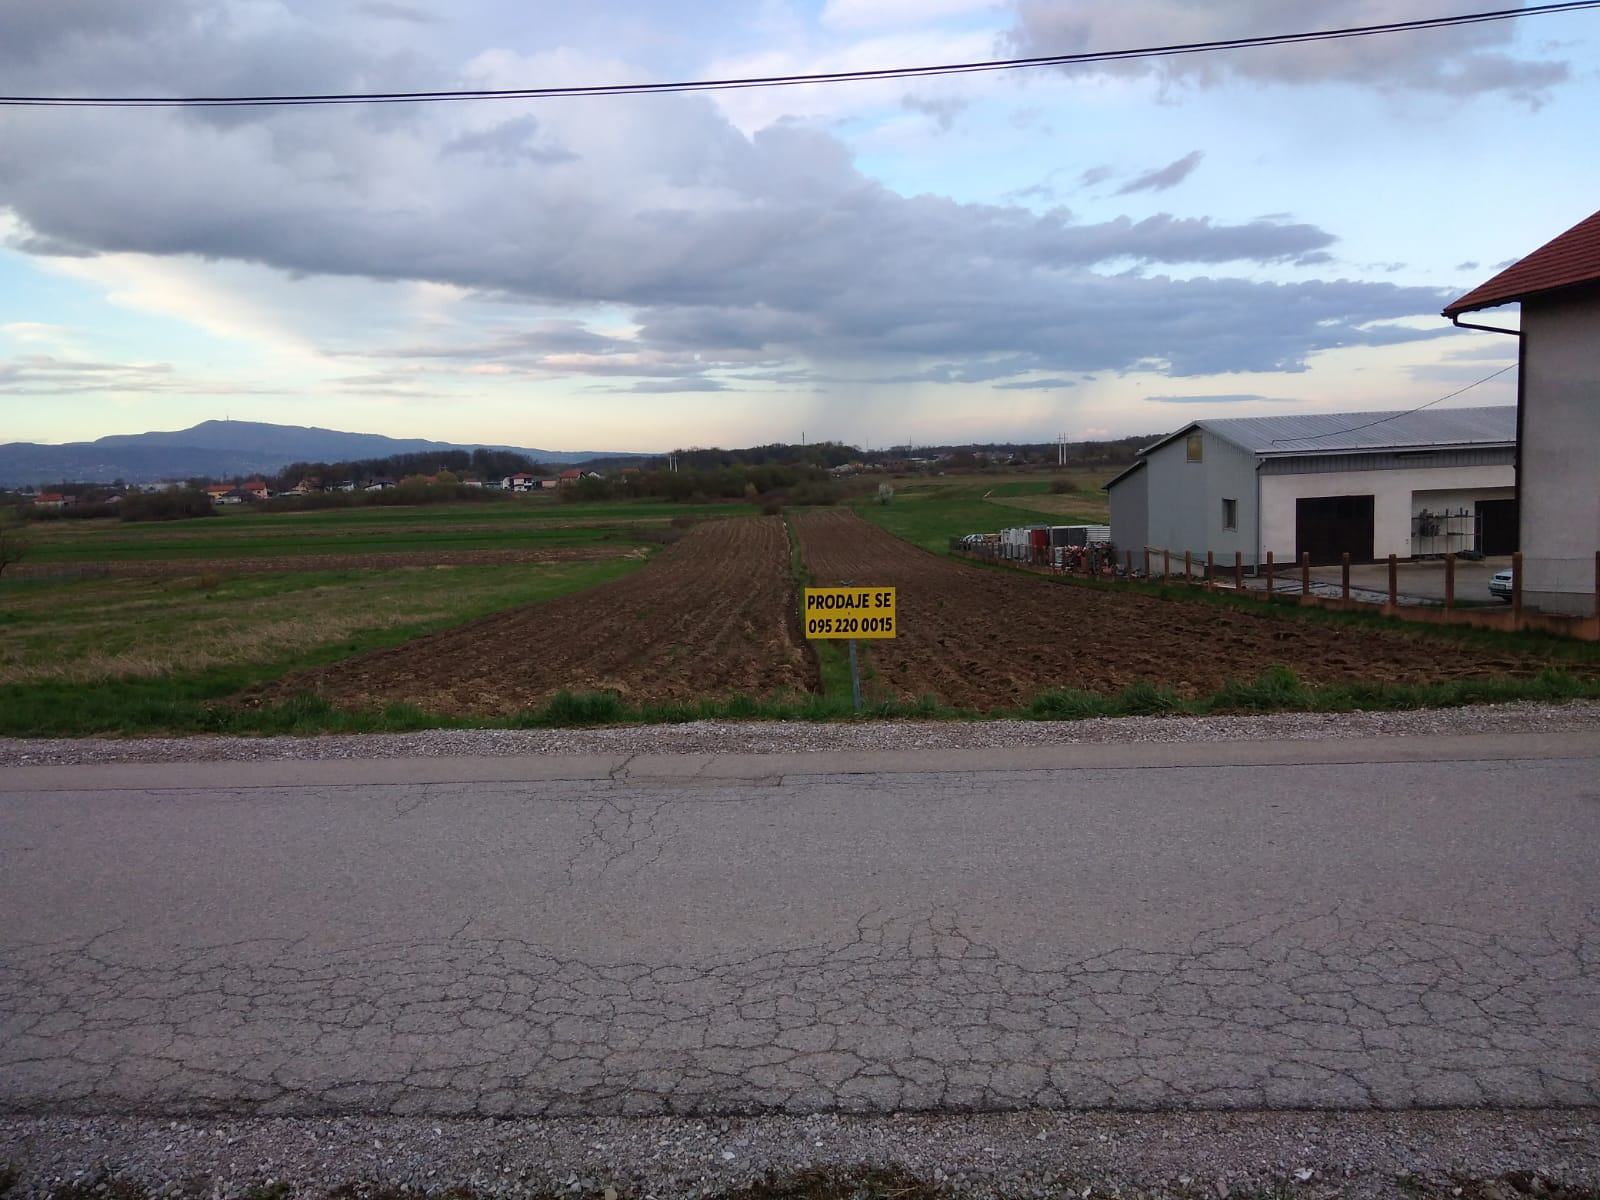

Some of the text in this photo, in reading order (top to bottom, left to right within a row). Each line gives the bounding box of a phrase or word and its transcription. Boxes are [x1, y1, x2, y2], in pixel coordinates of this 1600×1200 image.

[807, 592, 892, 610] PRODAJE SE
[808, 617, 892, 633] 095 220 0015
